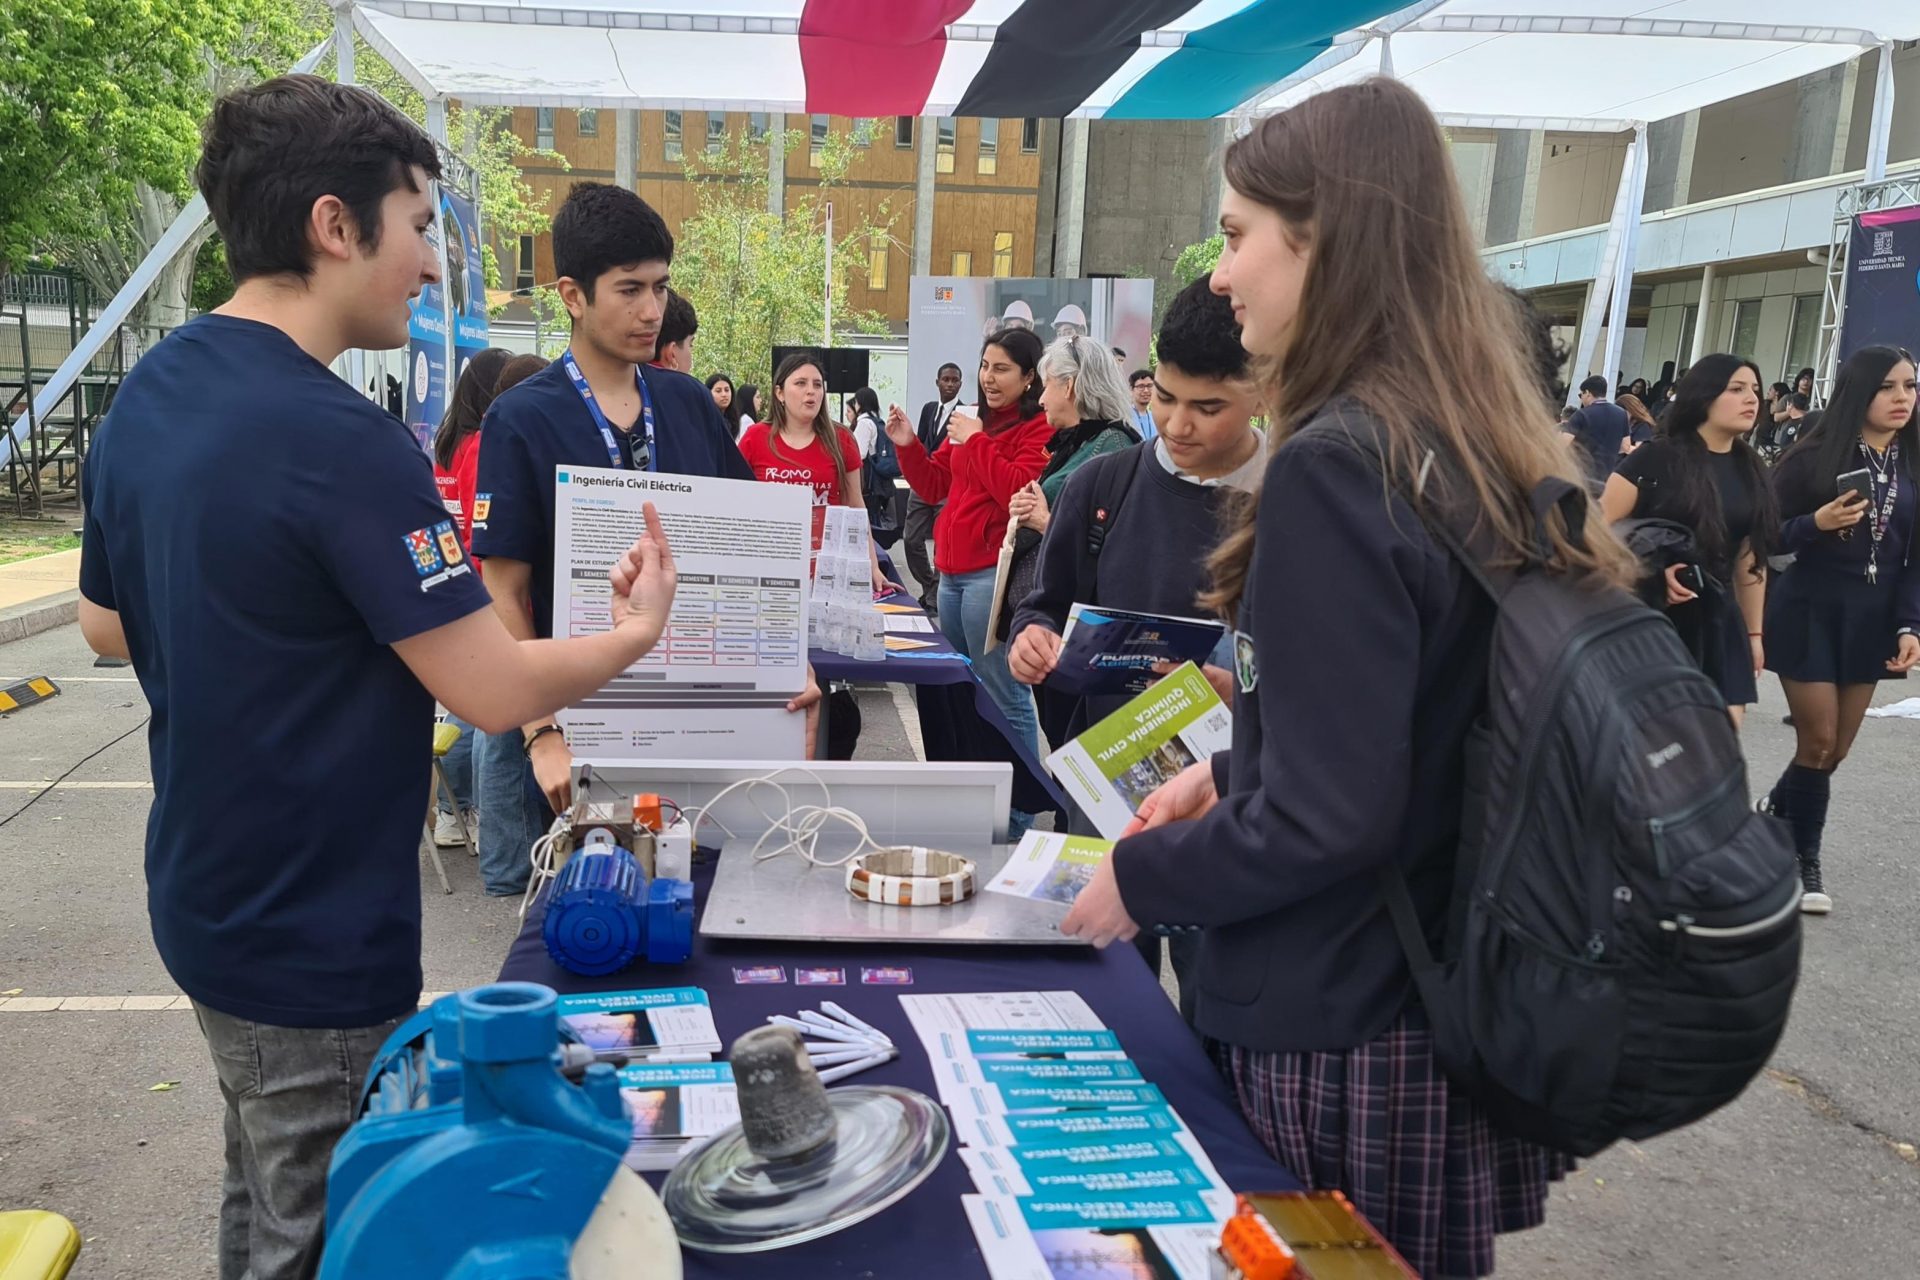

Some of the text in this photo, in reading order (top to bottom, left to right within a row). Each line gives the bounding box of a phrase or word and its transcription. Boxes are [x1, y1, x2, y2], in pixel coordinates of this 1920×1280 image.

[765, 467, 812, 480] PROMO
[572, 474, 692, 493] Ingeniería Civil Eléctrica
[770, 579, 795, 587] SEMESTRE
[1135, 687, 1184, 722] QUÍMICA
[1097, 696, 1192, 762] INGENIERÍA CIVIL
